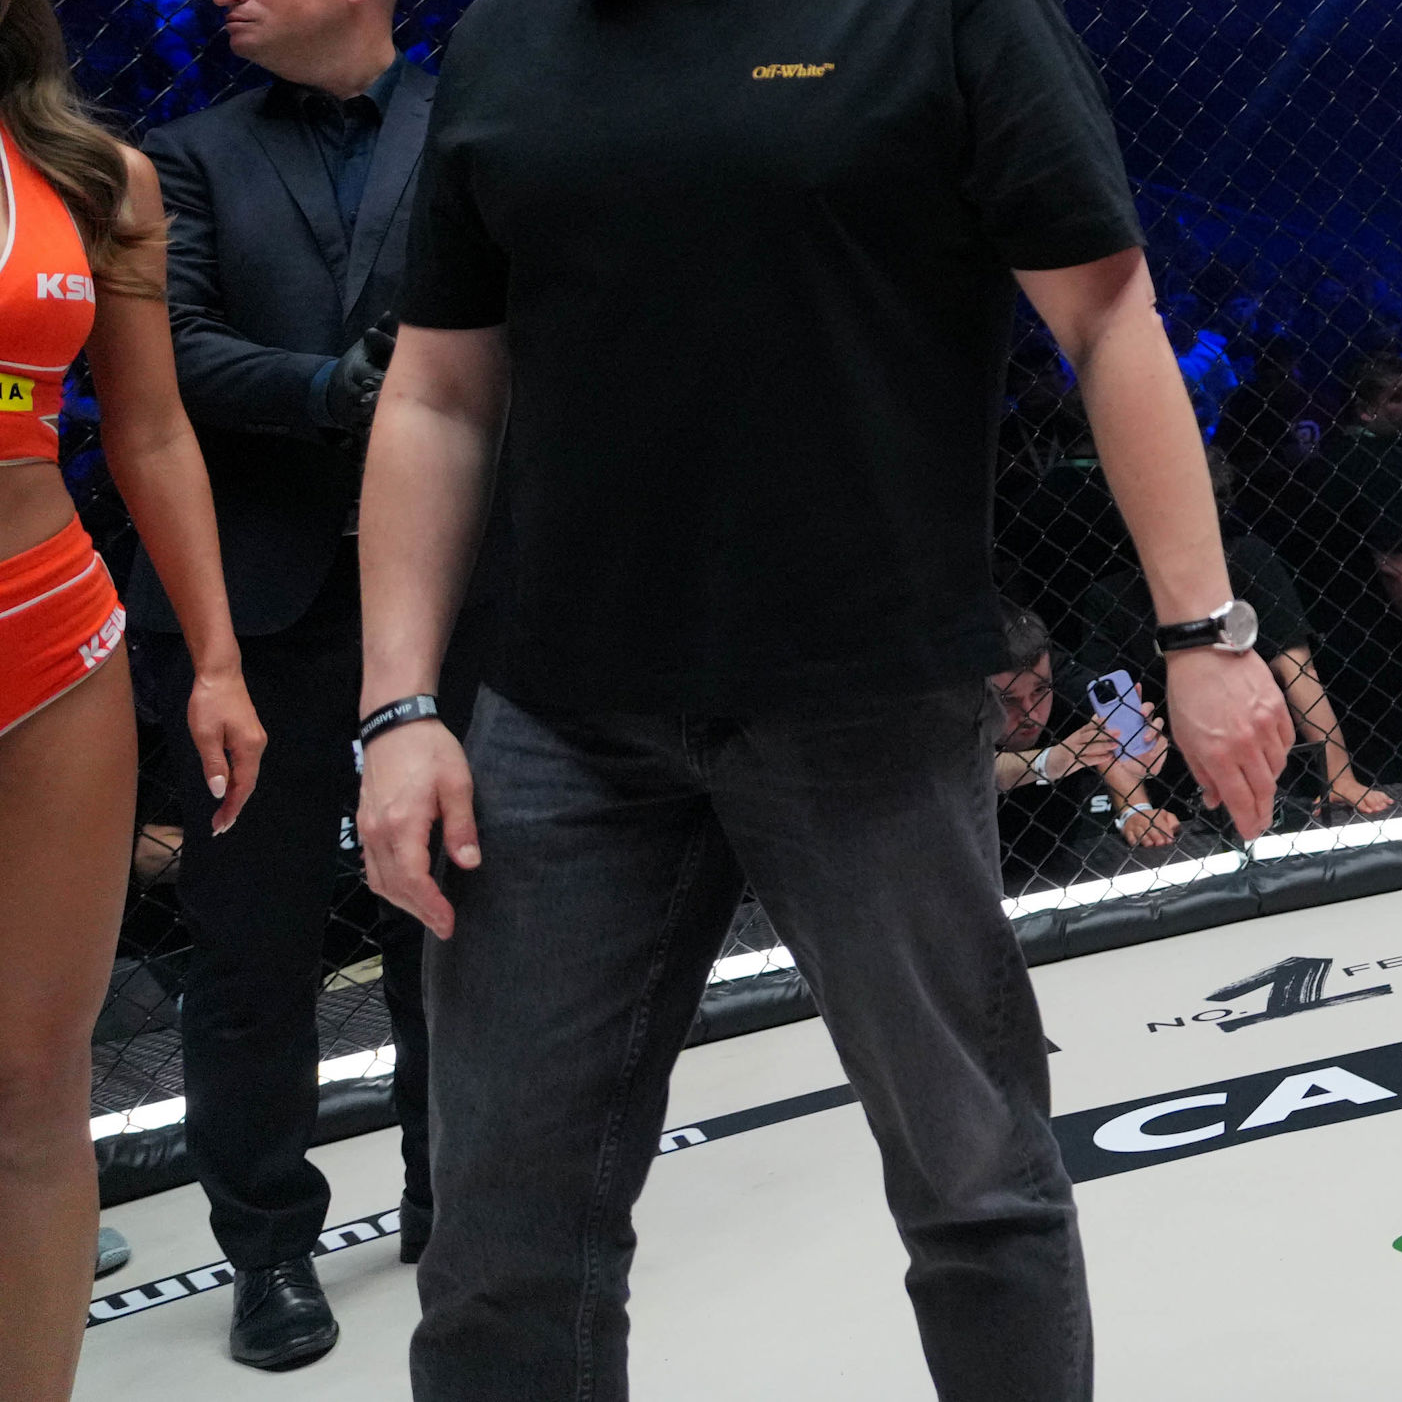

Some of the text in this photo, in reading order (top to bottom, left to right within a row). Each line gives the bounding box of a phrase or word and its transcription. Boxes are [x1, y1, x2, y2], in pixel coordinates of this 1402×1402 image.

[395, 703, 413, 716] VIP
[1146, 1008, 1248, 1033] NO.
[1202, 956, 1394, 1034] 1
